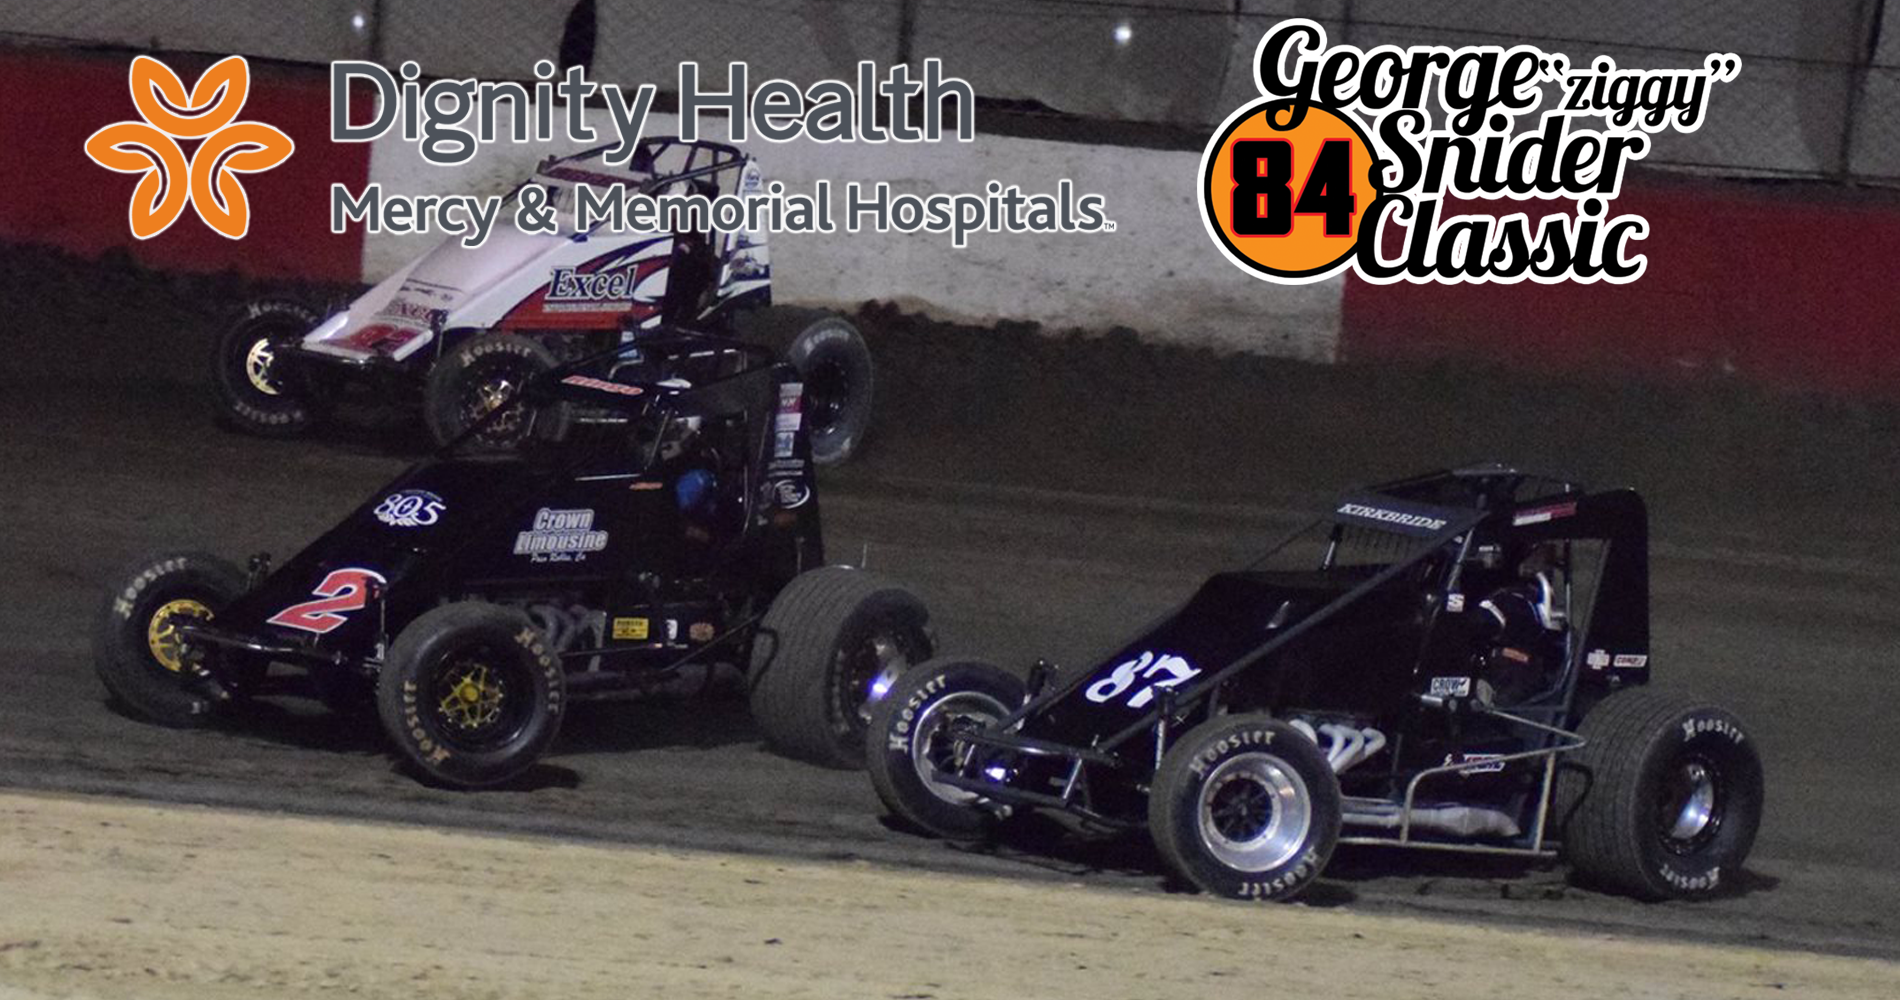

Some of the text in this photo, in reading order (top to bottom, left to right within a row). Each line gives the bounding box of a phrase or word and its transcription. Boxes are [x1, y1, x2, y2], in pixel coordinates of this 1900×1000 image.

[545, 264, 639, 300] Excel
[374, 494, 447, 525] 805
[534, 508, 594, 532] Crown
[1336, 502, 1447, 530] KIRKBRIDE
[266, 567, 386, 633] 2
[1085, 651, 1202, 709] 87
